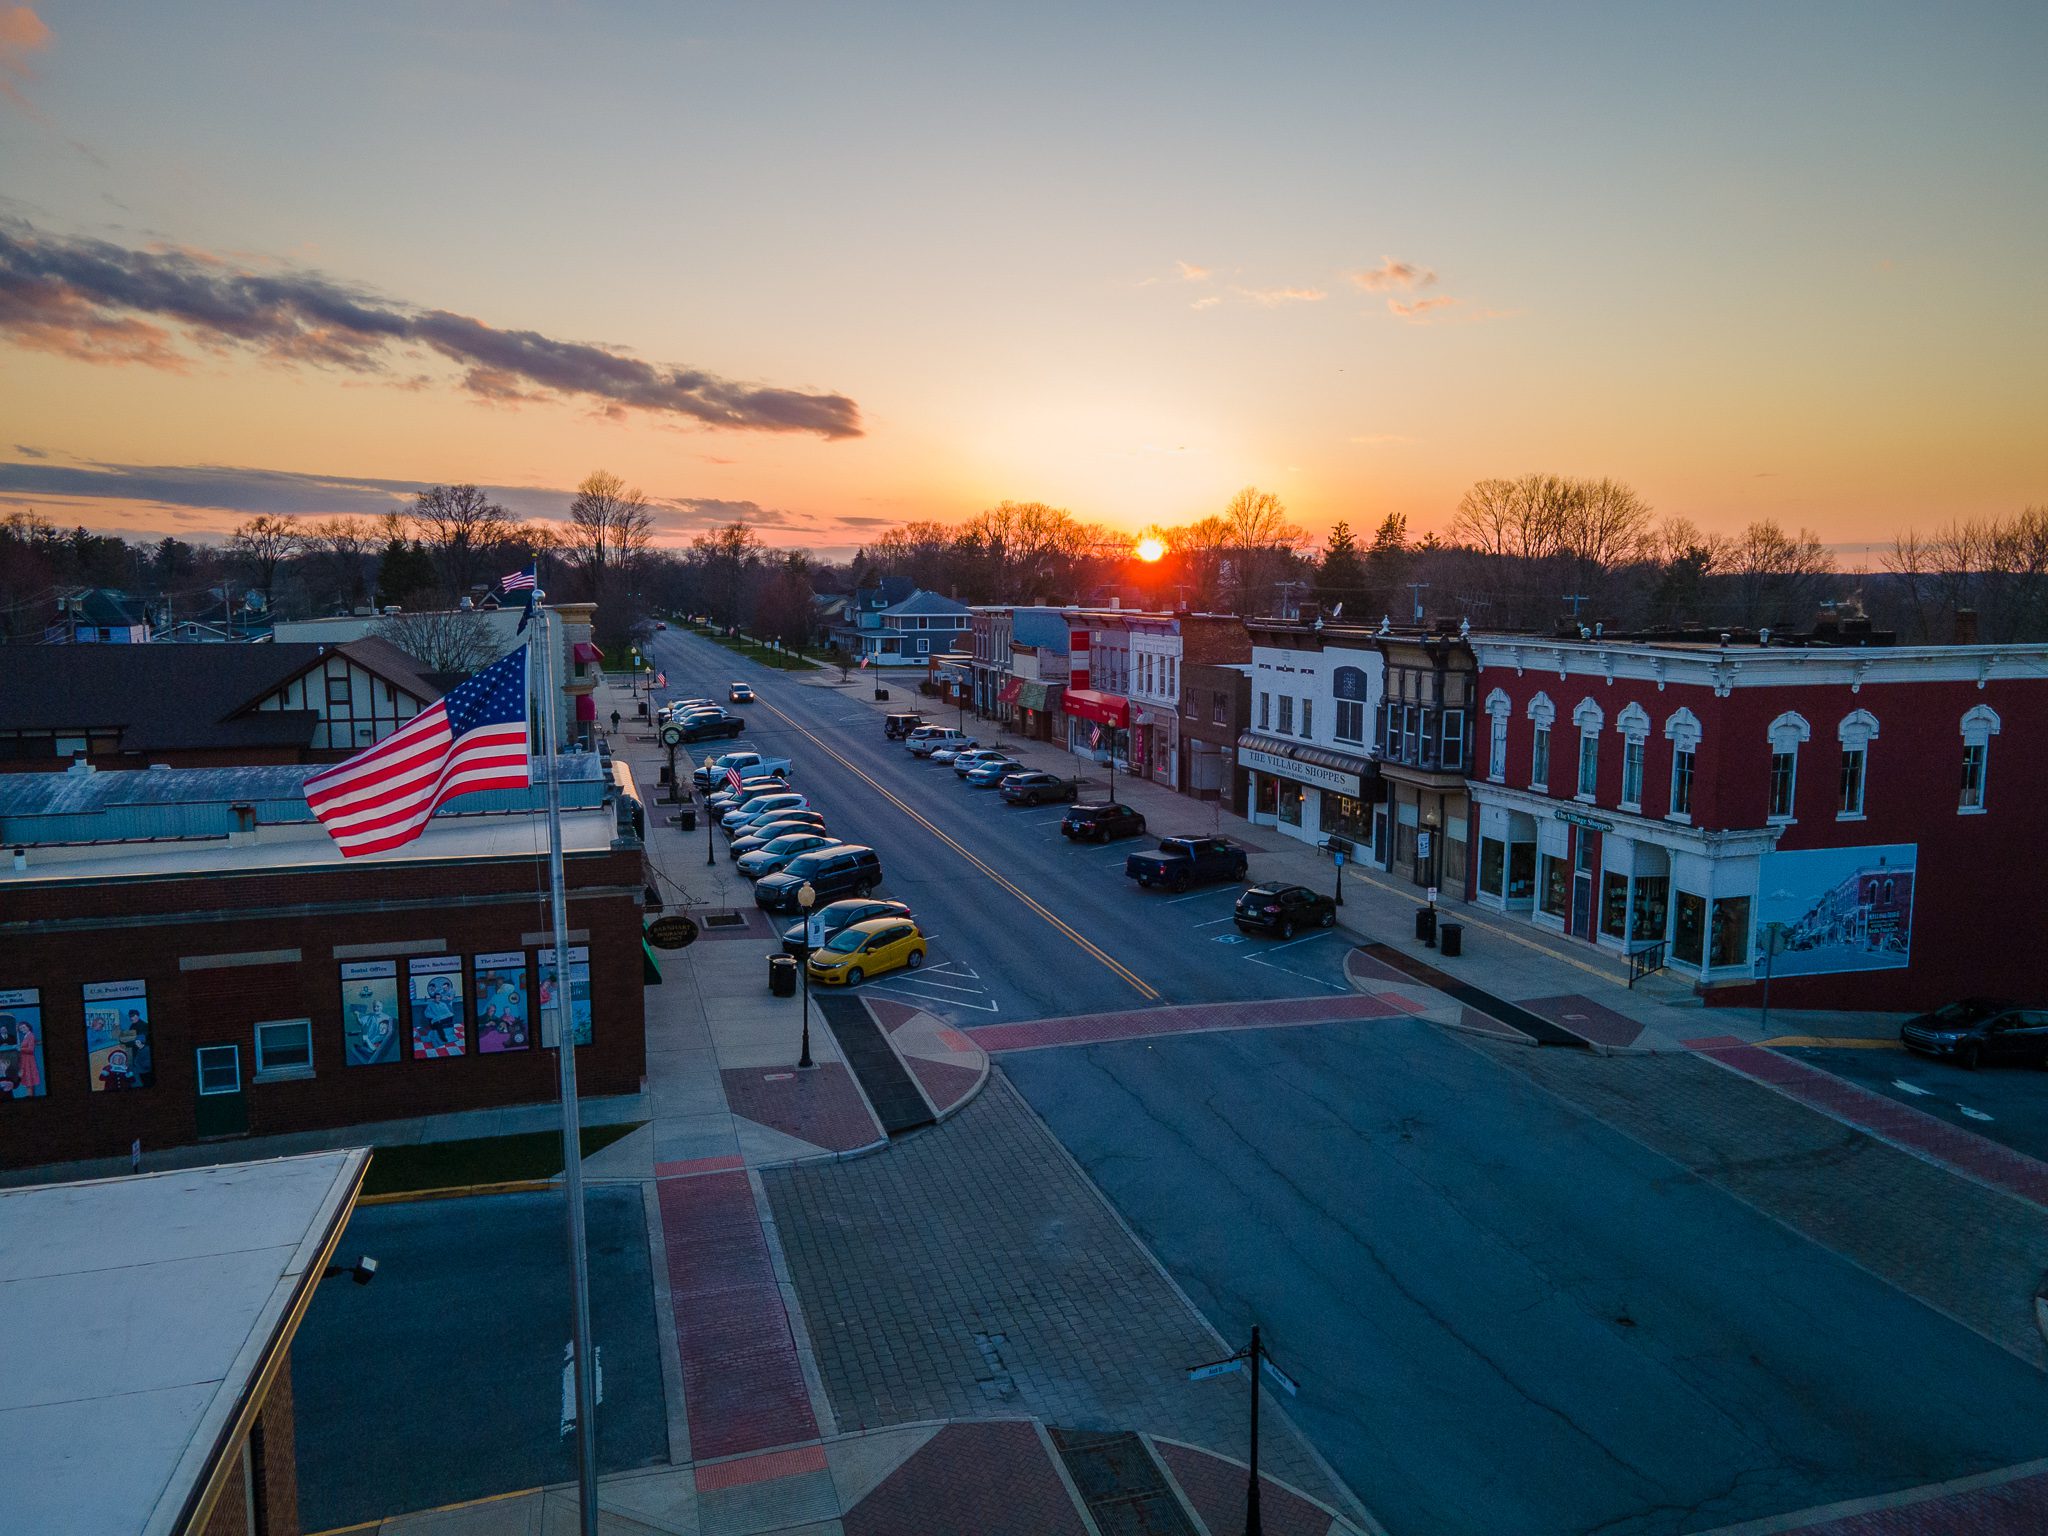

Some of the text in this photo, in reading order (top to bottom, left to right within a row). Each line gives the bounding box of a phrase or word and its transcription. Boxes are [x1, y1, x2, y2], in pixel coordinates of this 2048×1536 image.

[1249, 751, 1346, 784] THE VILLAGE SHOPPES
[1556, 811, 1612, 831] The Village Shoppes
